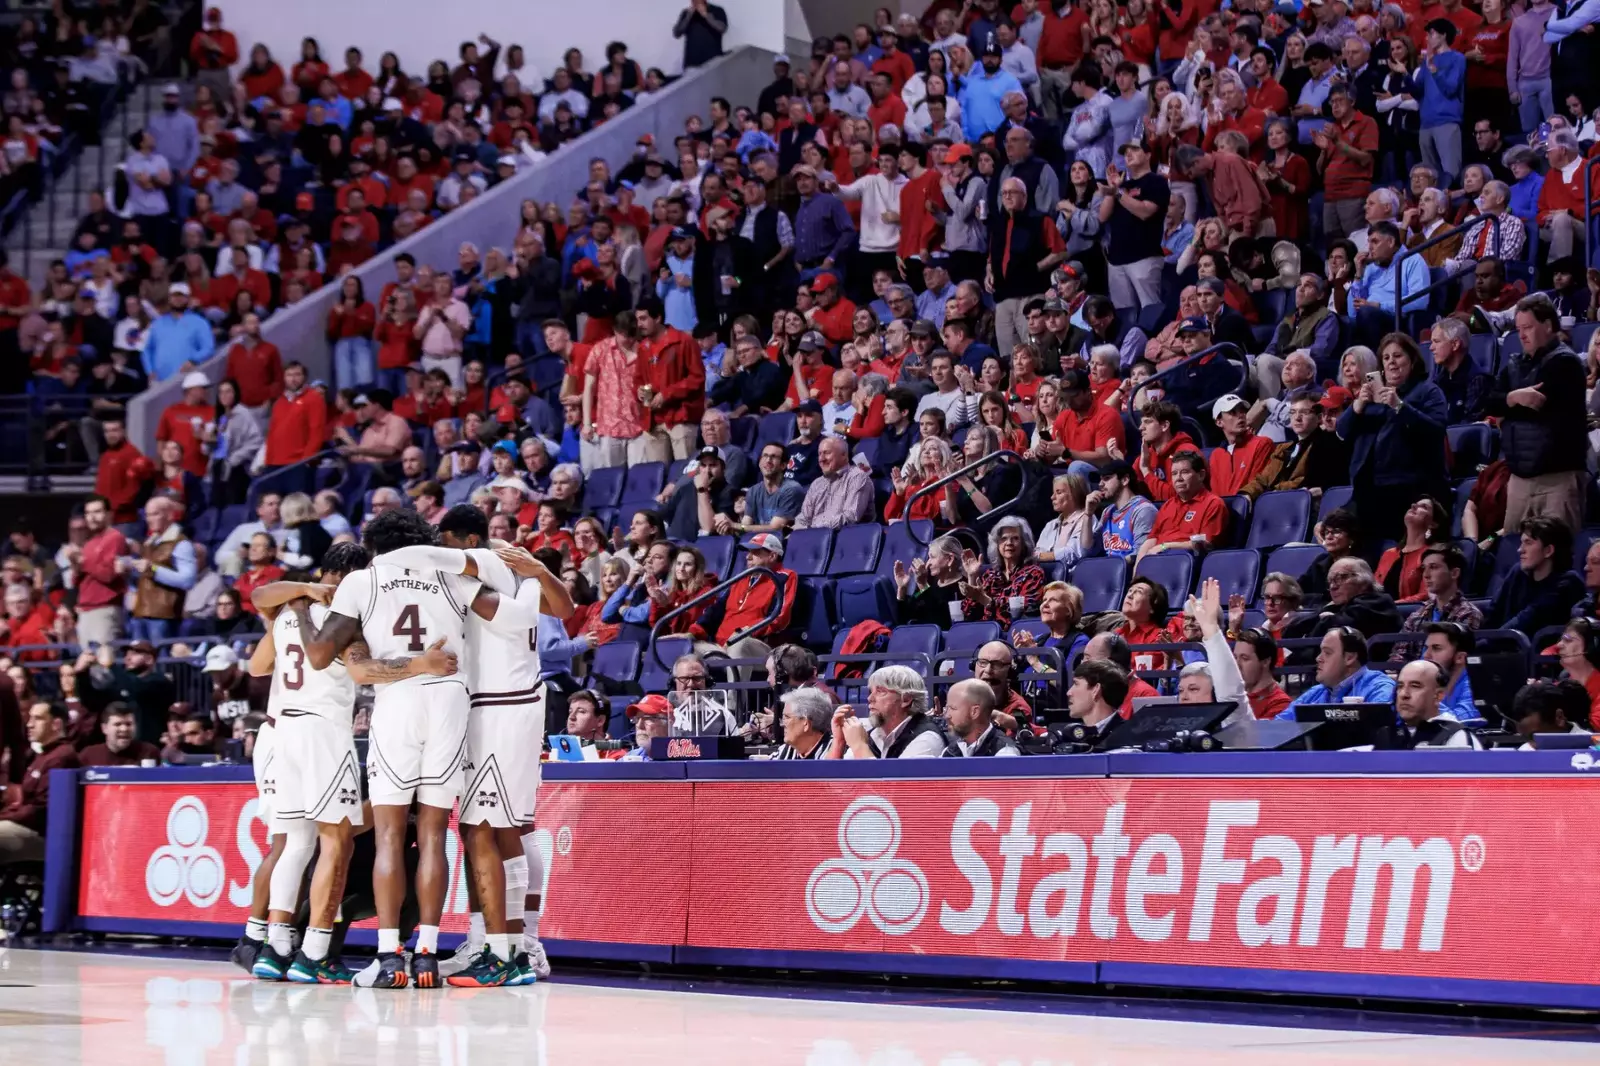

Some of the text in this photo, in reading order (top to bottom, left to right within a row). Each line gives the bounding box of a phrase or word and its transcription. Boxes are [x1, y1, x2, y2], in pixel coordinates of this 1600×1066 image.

[380, 579, 440, 594] MATTHEWS
[392, 604, 426, 652] 4
[283, 643, 305, 691] 3
